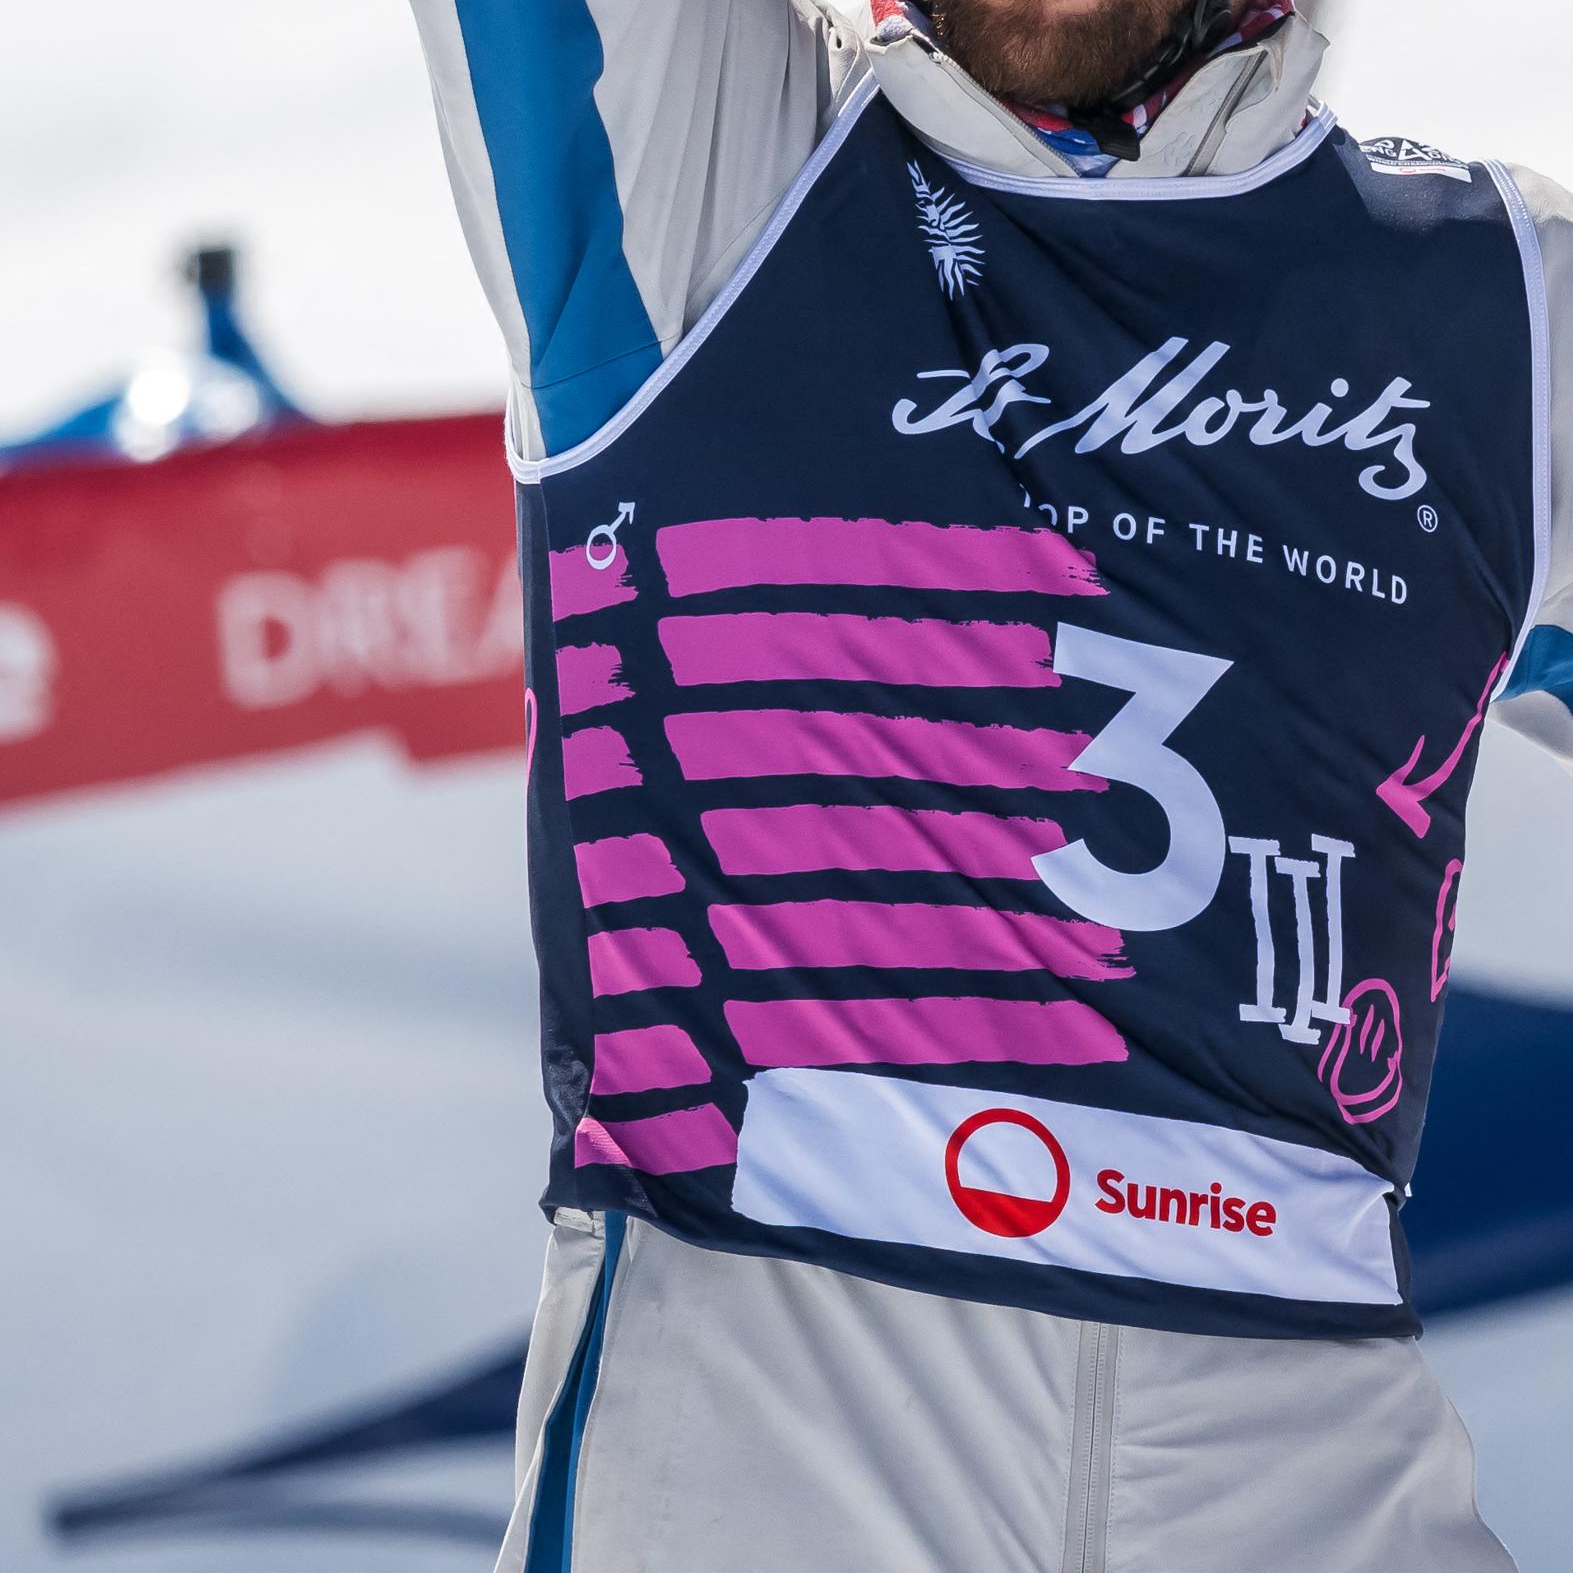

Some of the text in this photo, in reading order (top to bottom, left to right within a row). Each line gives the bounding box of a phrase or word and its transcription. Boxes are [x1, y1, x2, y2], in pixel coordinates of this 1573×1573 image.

[1013, 336, 1431, 501] Moritz
[1112, 512, 1166, 545] OF
[1188, 523, 1264, 564] THE
[1282, 544, 1407, 605] WORLD
[1031, 622, 1356, 1045] 3 III
[1095, 1169, 1277, 1237] Sunrise
